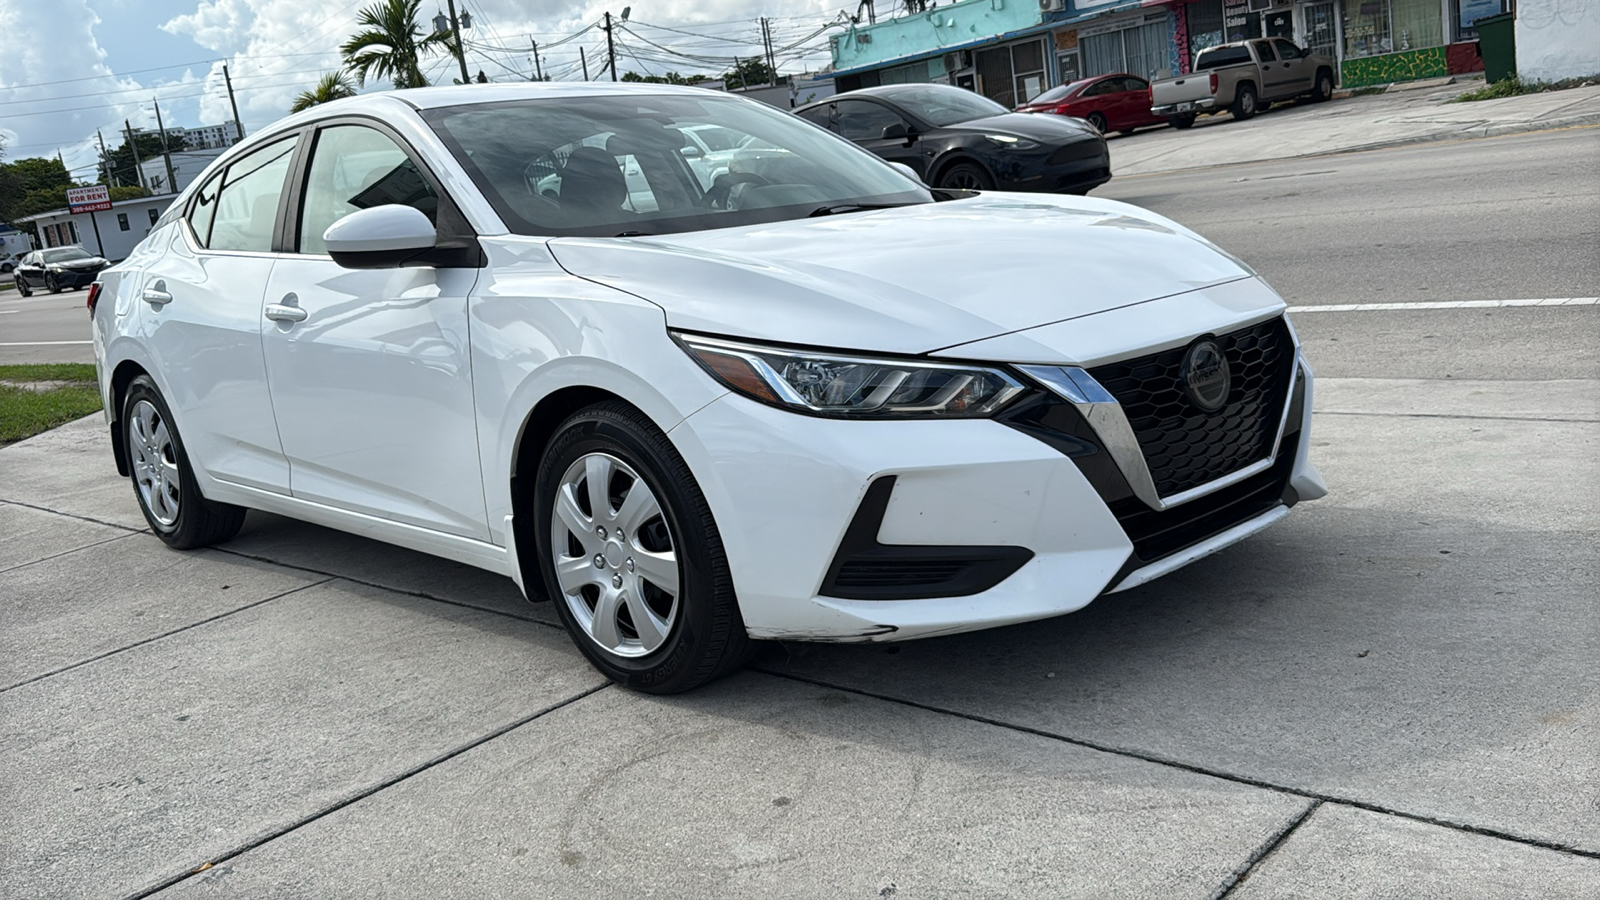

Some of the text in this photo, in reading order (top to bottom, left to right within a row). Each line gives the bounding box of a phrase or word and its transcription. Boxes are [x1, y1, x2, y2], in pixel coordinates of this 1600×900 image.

[1226, 6, 1248, 17] Beauty
[1226, 17, 1246, 28] Salon
[69, 187, 106, 195] APARTMENTS
[70, 192, 107, 203] FOR RENT
